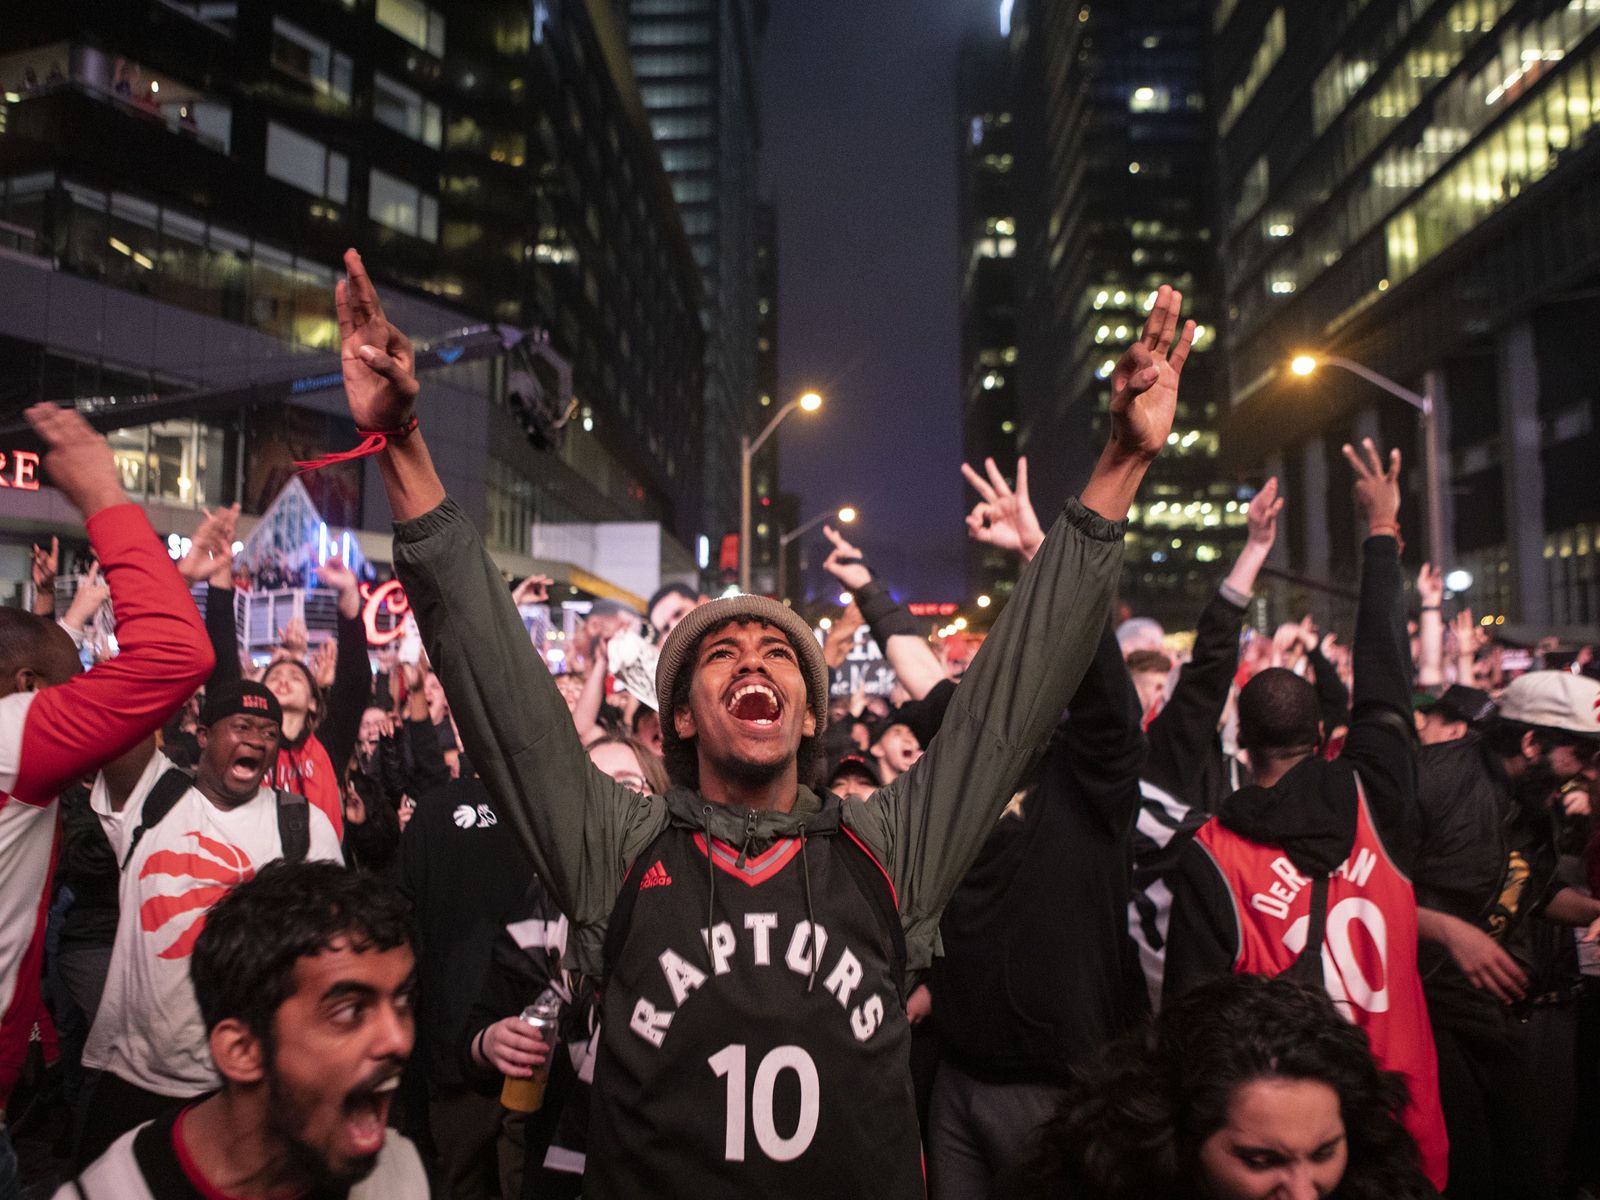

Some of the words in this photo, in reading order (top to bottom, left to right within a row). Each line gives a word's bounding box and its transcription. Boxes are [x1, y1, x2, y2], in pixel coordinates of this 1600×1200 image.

[640, 875, 672, 890] adidas
[629, 912, 884, 1048] RAPTORS
[707, 1043, 820, 1162] 10
